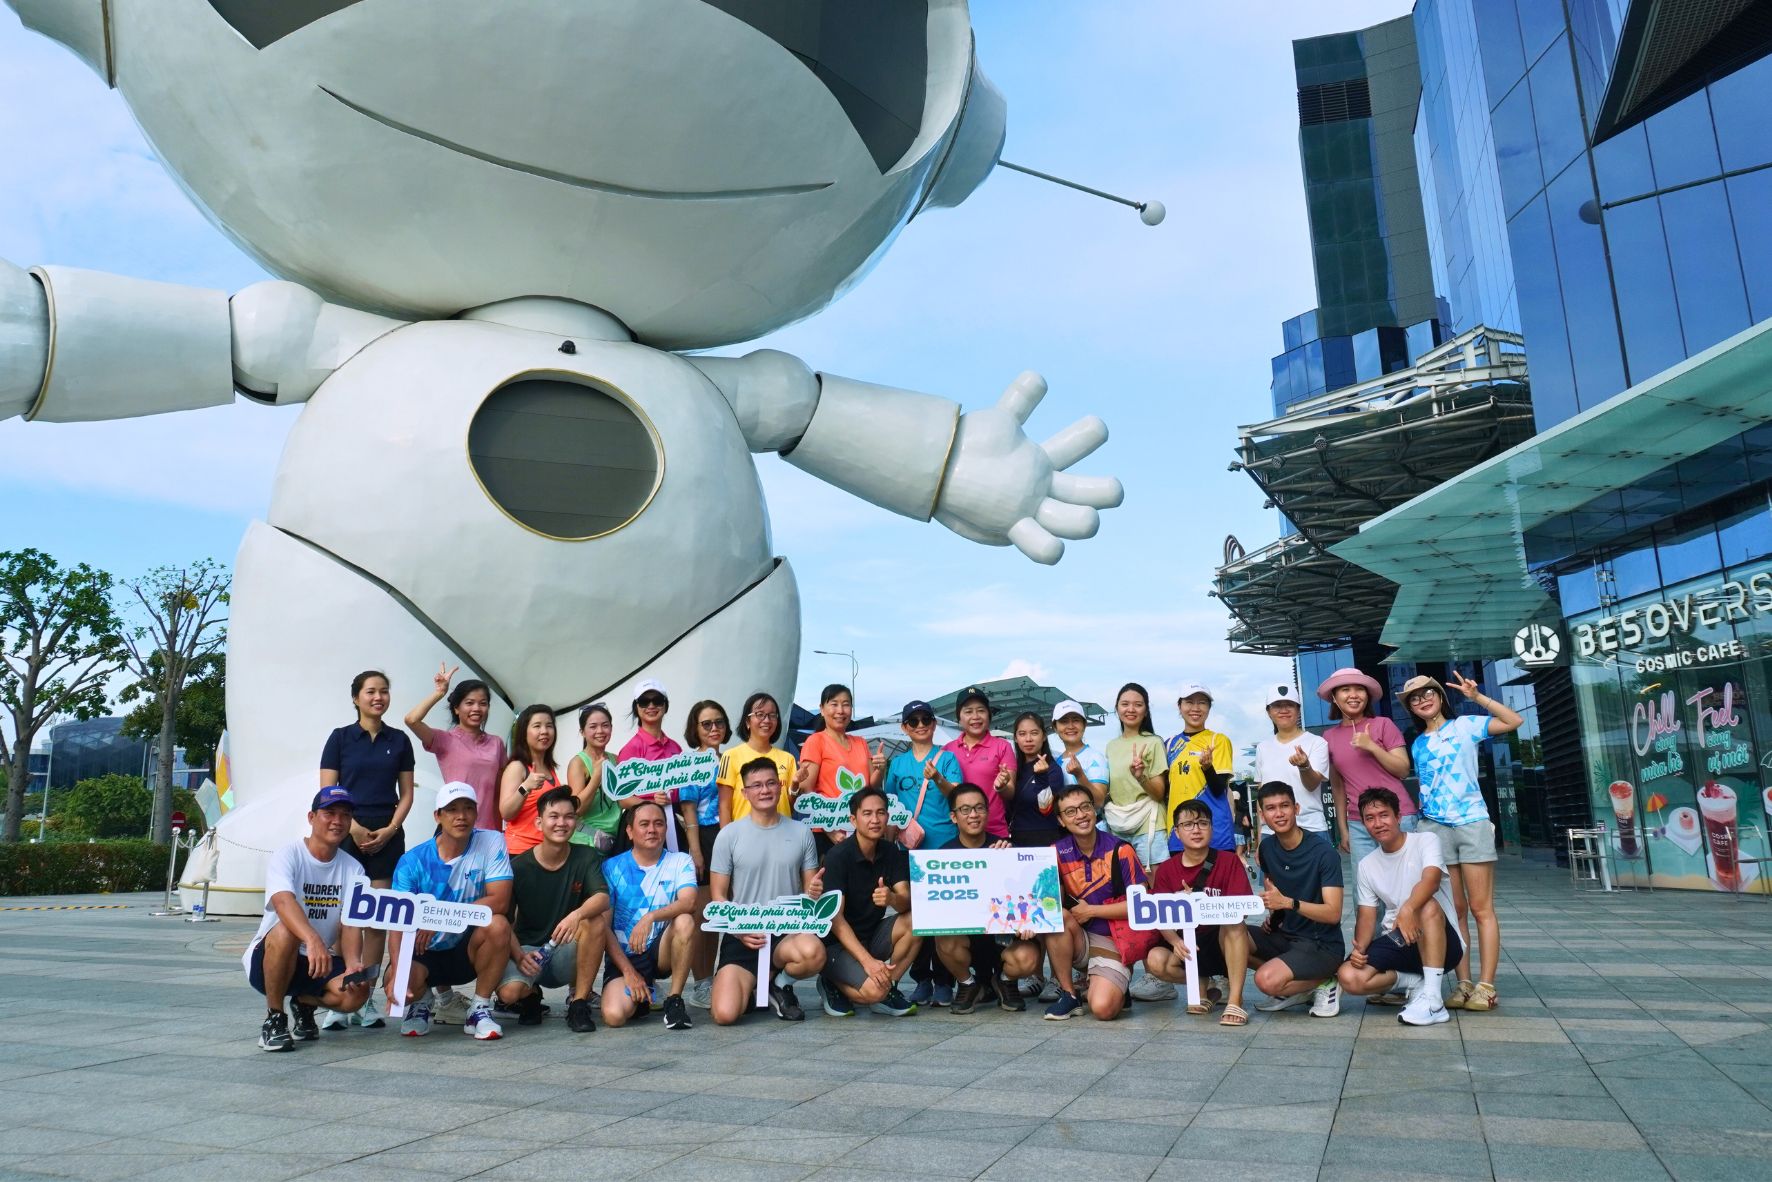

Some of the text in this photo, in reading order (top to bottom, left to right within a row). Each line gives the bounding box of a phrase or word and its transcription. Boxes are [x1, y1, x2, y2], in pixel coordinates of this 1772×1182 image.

[1696, 640, 1740, 663] CAFE
[1686, 682, 1739, 748] Feel
[1633, 690, 1681, 757] Chill
[666, 755, 692, 773] phải
[662, 772, 689, 790] phải
[690, 769, 711, 784] đẹp
[891, 811, 908, 825] cây
[926, 859, 987, 870] Green
[1017, 853, 1034, 862] bm
[927, 874, 970, 885] Run
[927, 889, 979, 901] 2025
[348, 884, 486, 926] bm BEHN MEYER
[1133, 892, 1259, 925] bm BEHN MEYER
[308, 909, 328, 920] RUN
[750, 906, 760, 917] là
[761, 906, 785, 919] phải
[786, 908, 811, 920] chạy
[1201, 911, 1238, 920] Since 1840
[422, 916, 462, 928] Since 1840
[766, 920, 776, 930] là
[777, 920, 800, 932] phải
[802, 918, 828, 933] trồng
